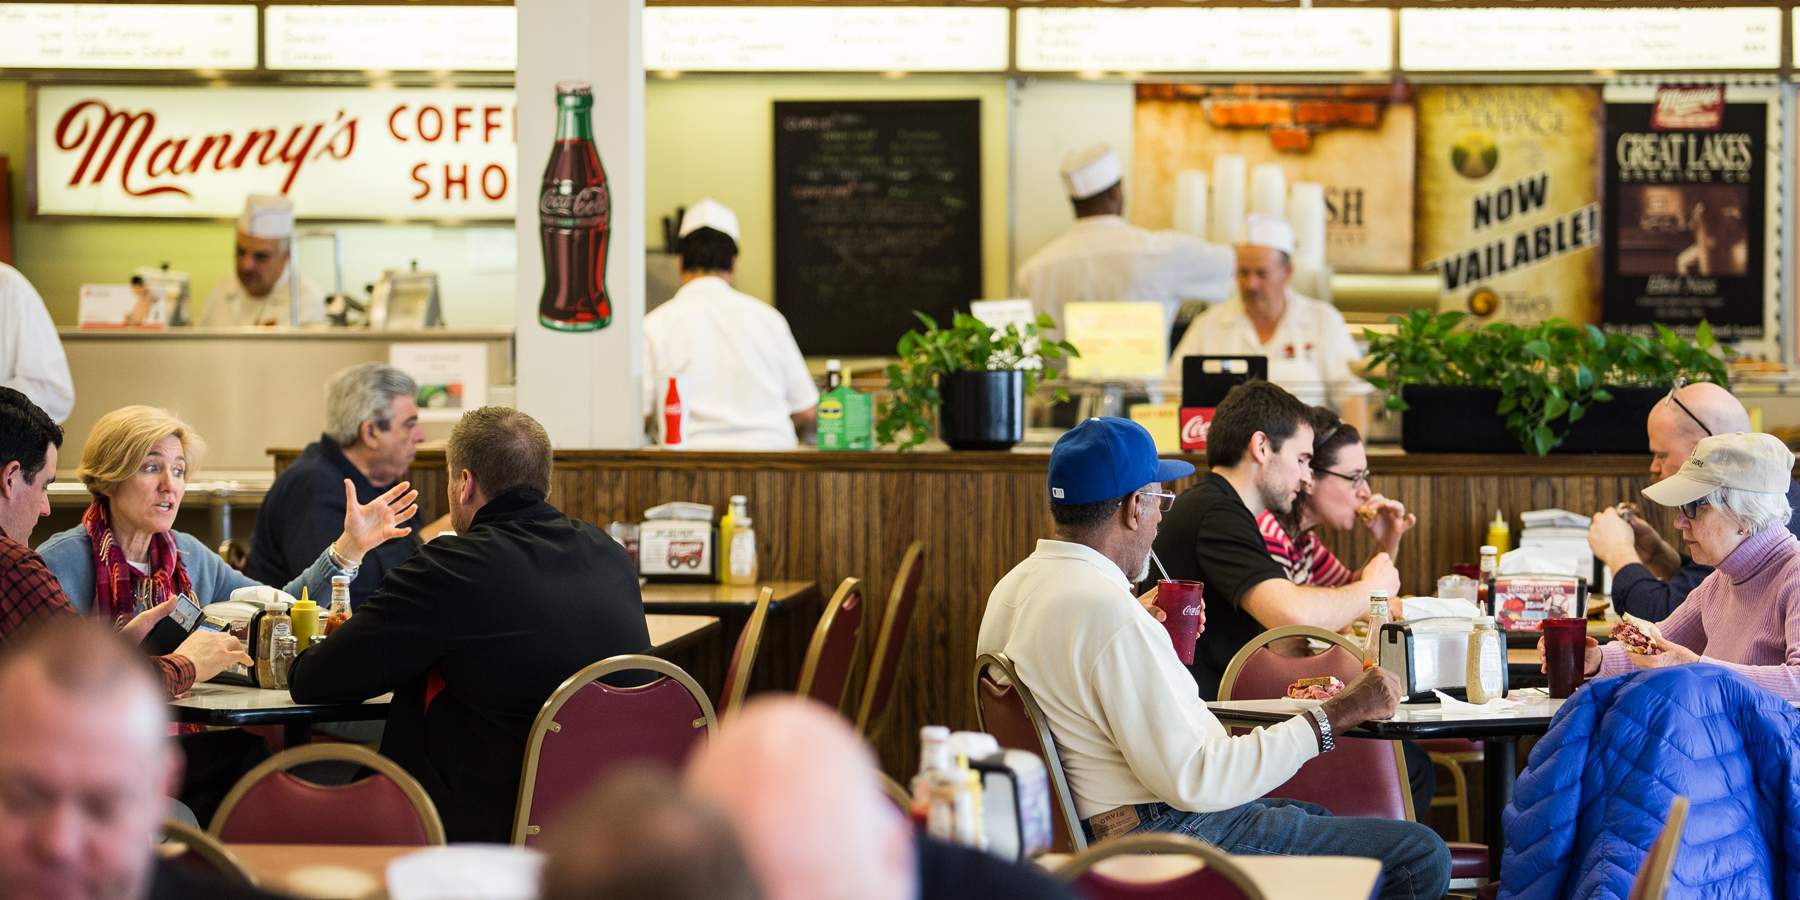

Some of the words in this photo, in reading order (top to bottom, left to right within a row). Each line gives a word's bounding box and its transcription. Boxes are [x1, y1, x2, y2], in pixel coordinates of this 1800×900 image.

[388, 105, 517, 143] COFF
[54, 99, 359, 199] Manny's
[1616, 132, 1685, 171] GREAT
[1687, 132, 1753, 171] LAKES
[410, 161, 510, 201] SHO
[1472, 172, 1552, 230] NOW
[1443, 206, 1598, 291] VAILABLE!
[1100, 811, 1125, 824] ORVIS
